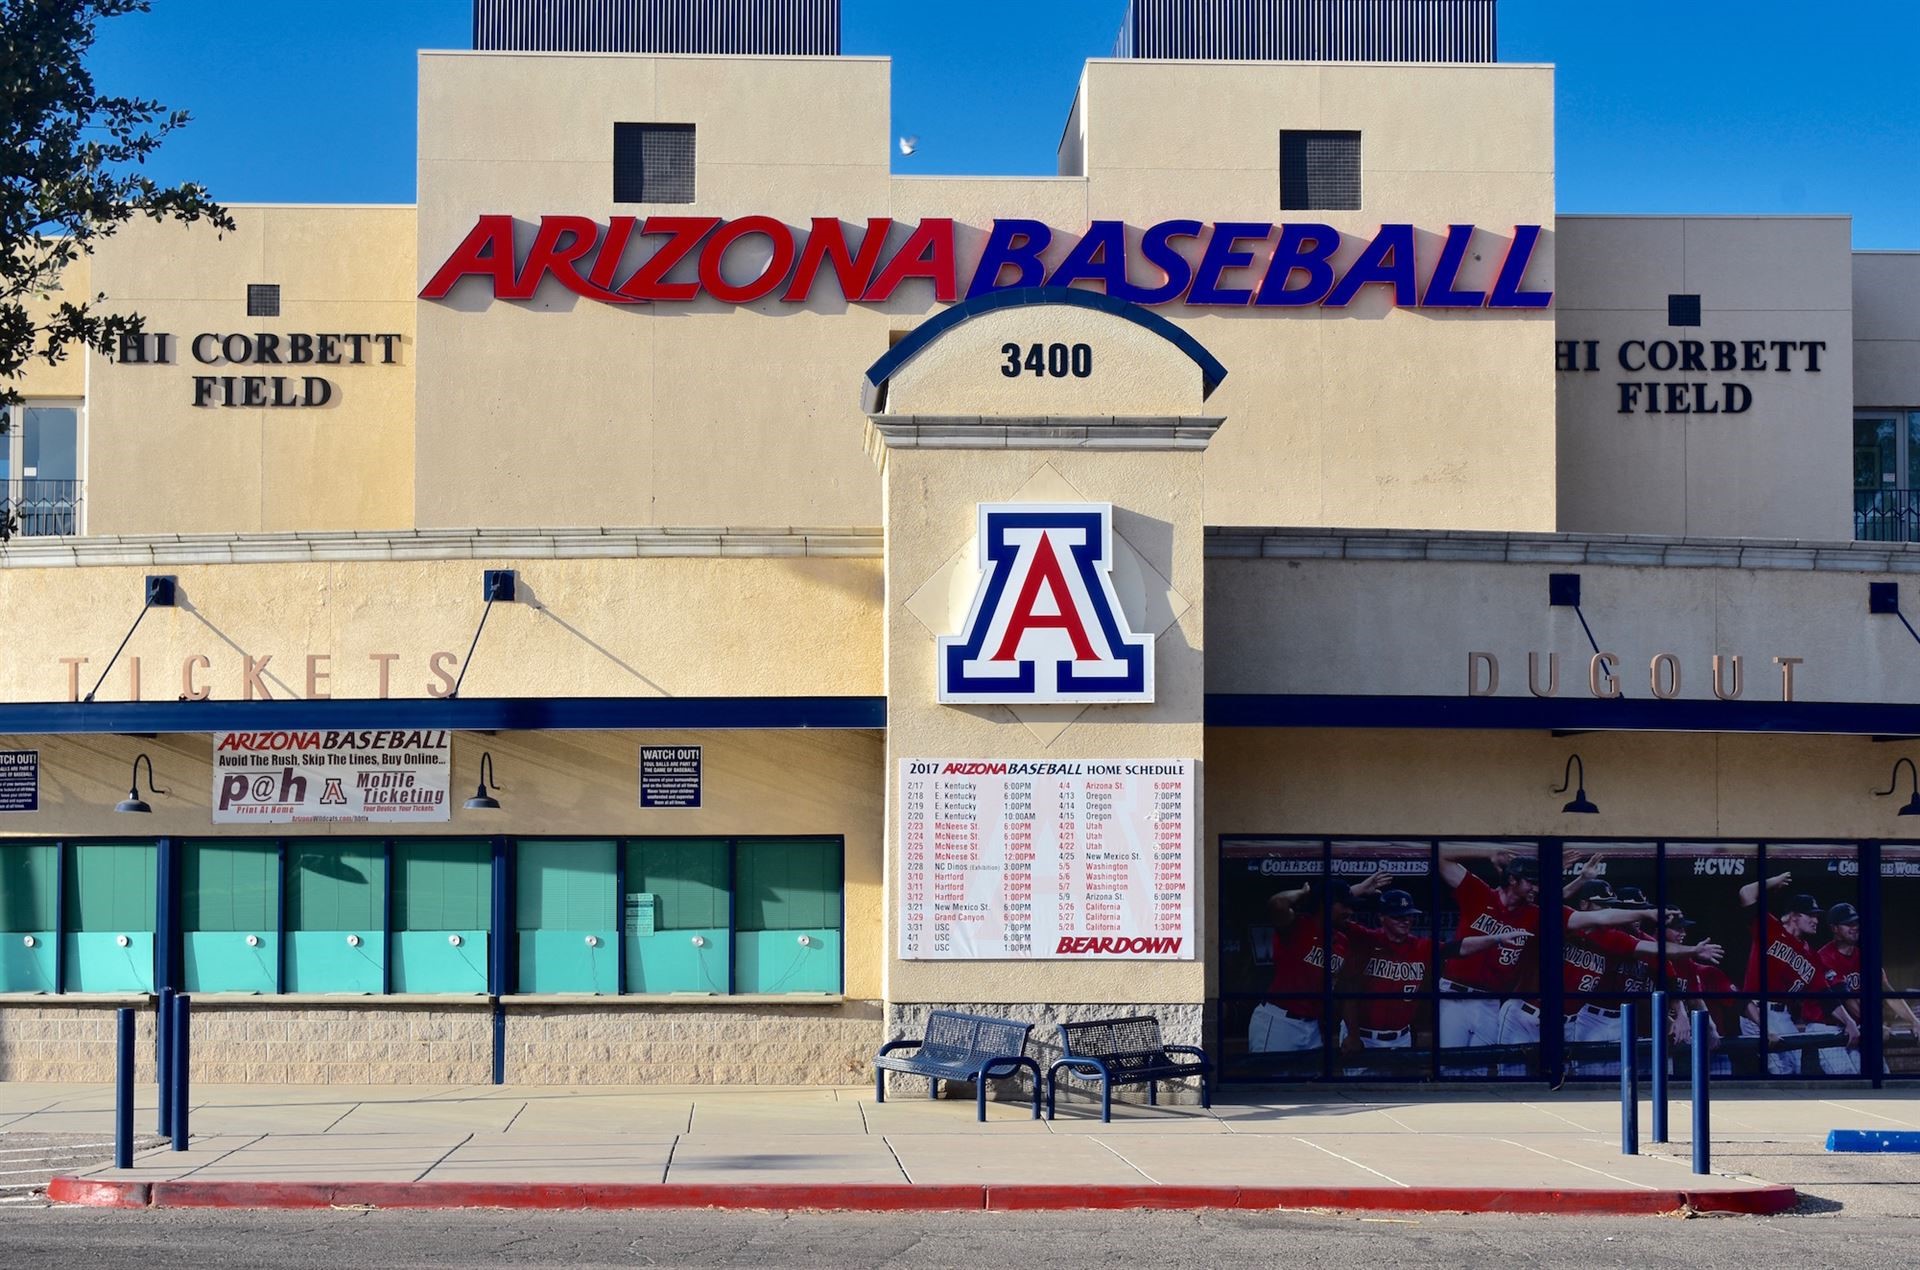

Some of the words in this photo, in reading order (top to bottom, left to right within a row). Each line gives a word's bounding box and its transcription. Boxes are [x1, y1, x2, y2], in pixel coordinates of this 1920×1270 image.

[418, 214, 957, 304] ARIZONA
[966, 219, 1554, 308] BASEBALL
[117, 332, 170, 363] HI
[192, 332, 401, 364] CORBETT
[1000, 342, 1092, 378] 3400
[1555, 340, 1600, 371] HI
[1618, 340, 1826, 372] CORBETT
[192, 376, 332, 407] FIELD
[1617, 382, 1753, 414] FIELD
[938, 503, 1154, 703] A
[58, 651, 458, 702] TICKETS
[1468, 652, 1804, 702] DUGOUT
[218, 731, 321, 751] ARIZONA
[322, 731, 448, 750] BASEBALL
[0, 754, 16, 765] TCH
[17, 754, 37, 765] OUT!
[219, 754, 248, 767] Avoid
[250, 754, 269, 767] The
[302, 754, 325, 767] Skip
[327, 754, 347, 766] The
[349, 753, 380, 766] Lines,
[382, 753, 401, 766] Buy
[404, 753, 447, 766] Online...
[643, 749, 676, 760] WATCH
[677, 749, 700, 760] OUT!
[910, 763, 939, 774] 2017
[942, 762, 1006, 775] ARIZONA
[1007, 763, 1083, 775] BASEBALL
[1087, 765, 1122, 775] HOME
[1125, 765, 1184, 775] SCHEDULE
[356, 772, 415, 788] Mobile
[320, 778, 347, 804] A
[907, 782, 923, 790] 2/17
[935, 782, 942, 790] E.
[944, 782, 976, 791] Kentucky
[1004, 782, 1031, 790] 6:00PM
[1059, 782, 1070, 790] 4/4
[1086, 782, 1112, 790] Arizona
[1115, 782, 1124, 790] St.
[1154, 782, 1181, 790] 6:00PM
[363, 788, 445, 804] Ticketing
[907, 792, 923, 800] 2/18
[935, 792, 942, 800] E.
[944, 792, 976, 801] Kentucky
[1004, 792, 1031, 800] 6:00PM
[1059, 792, 1075, 800] 4/13
[1086, 792, 1112, 801] Oregon
[1154, 792, 1181, 800] 7:00PM
[271, 806, 294, 814] Home
[907, 802, 923, 810] 2/19
[935, 802, 942, 810] E.
[944, 802, 976, 811] Kentucky
[1004, 802, 1031, 810] 1:00PM
[907, 812, 923, 820] 2/20
[935, 812, 942, 820] E.
[944, 812, 976, 821] Kentucky
[1004, 812, 1035, 820] 10:00AM
[1059, 812, 1075, 820] 4/15
[1086, 812, 1112, 821] Oregon
[907, 822, 923, 830] 2/23
[935, 822, 968, 830] McNeese
[970, 822, 980, 830] St.
[1004, 822, 1031, 830] 6:00PM
[1059, 822, 1075, 830] 4/20
[1086, 822, 1102, 830] Utah
[1154, 822, 1181, 830] 6:00PM
[1059, 832, 1075, 840] 4/21
[1086, 832, 1102, 840] Utah
[1154, 832, 1181, 840] 7:00PM
[1086, 863, 1128, 872] Washington
[1262, 859, 1324, 875] COLLEGE
[1330, 859, 1376, 874] WORLD
[1378, 859, 1429, 874] SERIES
[1694, 858, 1745, 875] #CWS
[1086, 883, 1128, 892] Washington
[958, 913, 984, 922] Canyon
[907, 923, 923, 931] 3/31
[935, 923, 950, 931] USC
[1004, 923, 1031, 931] 7:00PM
[1059, 923, 1075, 931] 5/28
[1086, 923, 1120, 931] California
[1154, 923, 1181, 931] 1:30PM
[907, 933, 918, 941] 4/1
[935, 933, 950, 941] USC
[1004, 933, 1031, 941] 6:00PM
[907, 943, 918, 951] 4/2
[935, 943, 950, 951] USC
[1004, 943, 1031, 951] 1:00PM
[1767, 939, 1817, 984] ARIZONA
[1366, 958, 1425, 981] ARIZONA
